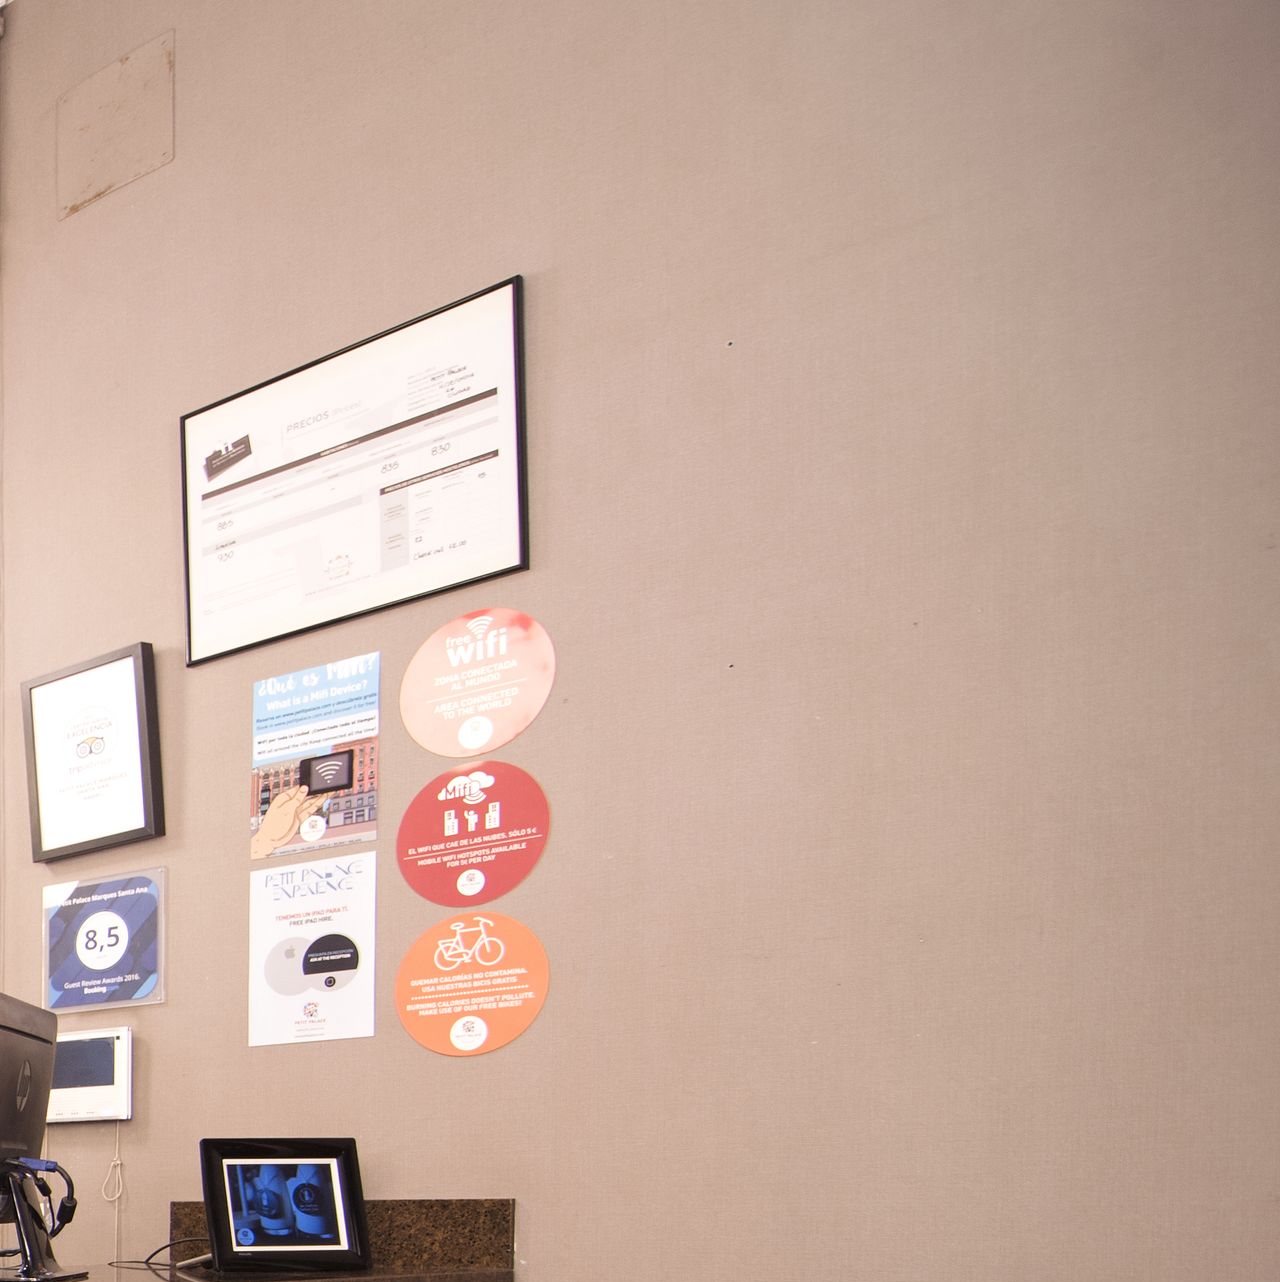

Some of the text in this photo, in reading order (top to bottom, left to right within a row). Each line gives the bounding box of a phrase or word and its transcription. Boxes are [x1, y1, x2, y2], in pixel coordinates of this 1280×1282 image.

[286, 410, 329, 433] PRECIOS
[446, 635, 471, 648] free
[447, 627, 508, 667] wifi
[302, 671, 320, 687] es
[434, 659, 518, 687] ZONA CONECTADA
[465, 672, 501, 688] MUNDO
[330, 679, 368, 697] Device?
[460, 687, 519, 707] CONNECTED
[478, 698, 512, 713] WORLD
[417, 846, 431, 854] WIFI
[446, 841, 459, 849] CAE
[417, 842, 527, 867] MOBILE WIFI HOTSPOTS AVAILABLE
[446, 860, 459, 868] FOR
[72, 895, 91, 906] Palace
[118, 888, 135, 897] Santa
[135, 886, 148, 894] Ana
[85, 926, 120, 952] 8,5
[64, 980, 81, 989] Guest
[81, 977, 101, 987] Review
[102, 974, 124, 985] Awards
[436, 981, 472, 991] NUESTRAS
[406, 1002, 437, 1011] BURNING
[437, 997, 470, 1009] CALORIES
[418, 1008, 438, 1016] MAKE
[439, 1006, 453, 1014] USE
[453, 1005, 463, 1013] OF
[463, 1004, 478, 1012] OUR
[479, 1001, 497, 1010] FREE
